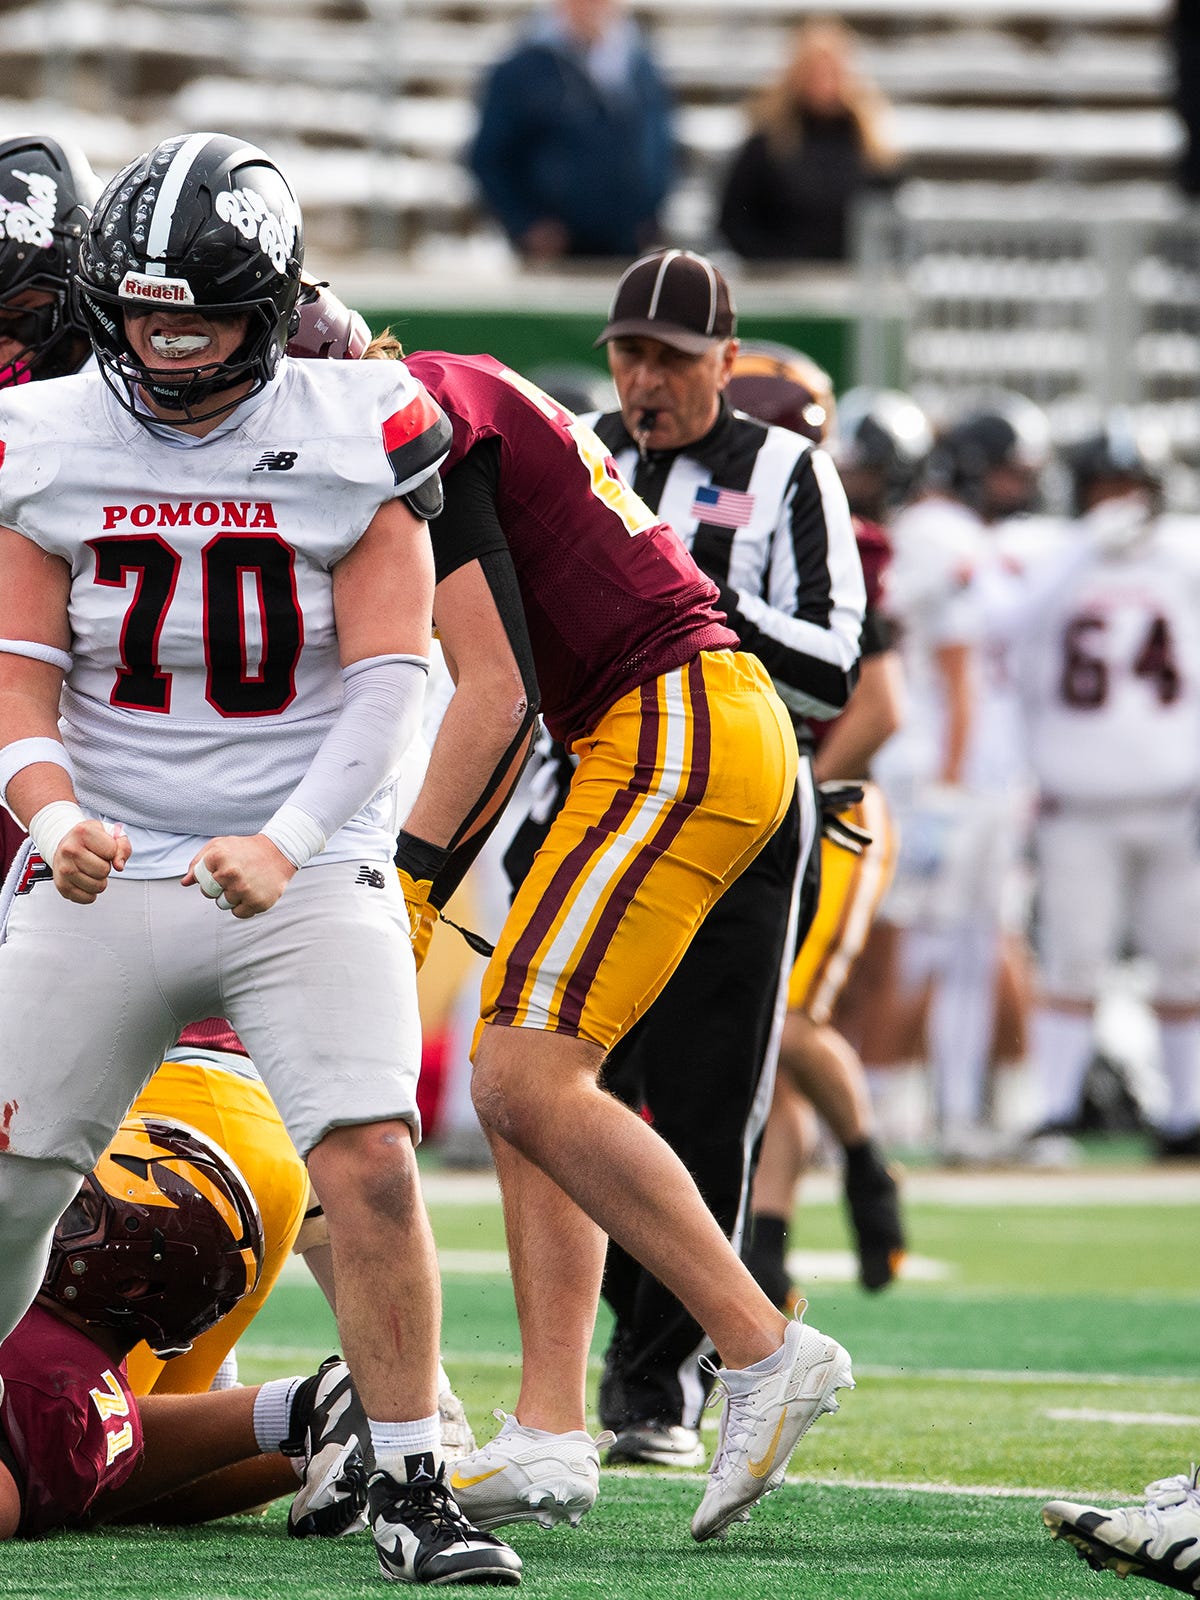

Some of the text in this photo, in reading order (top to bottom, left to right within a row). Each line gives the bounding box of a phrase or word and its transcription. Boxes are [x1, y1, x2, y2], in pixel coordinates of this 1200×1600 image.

[125, 281, 186, 301] Riddell
[102, 501, 278, 530] POMONA
[83, 531, 305, 719] 70
